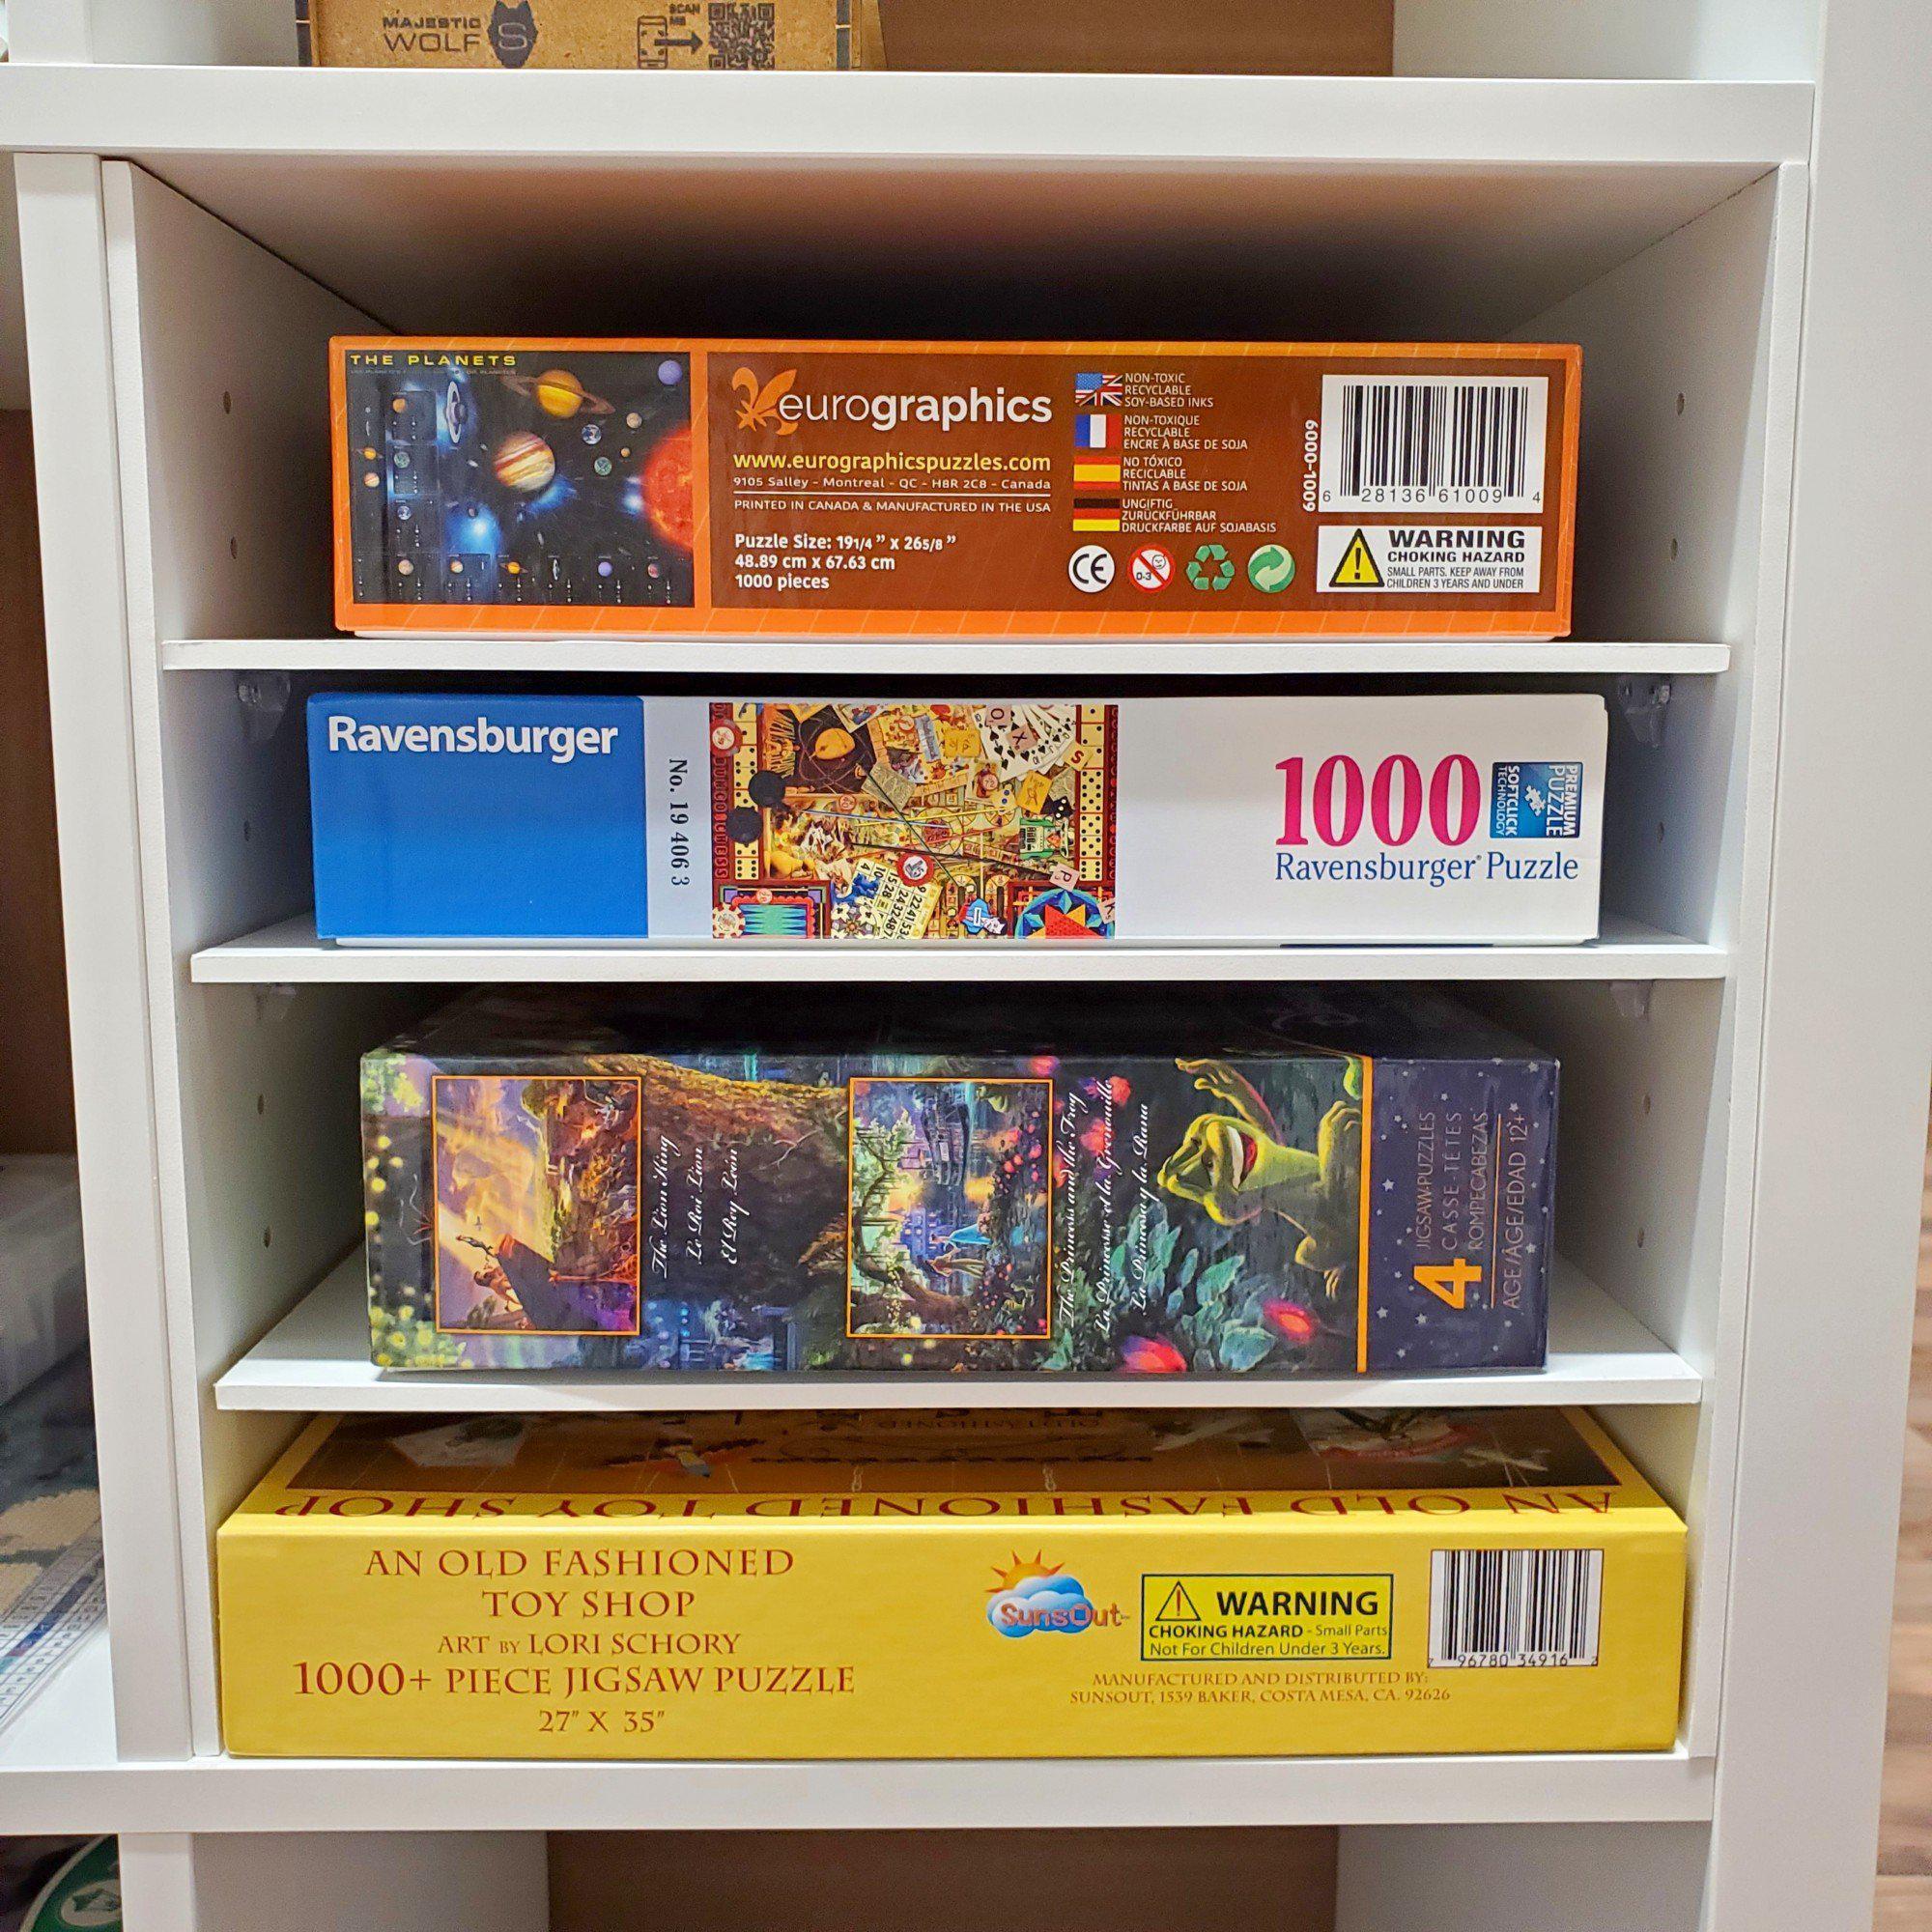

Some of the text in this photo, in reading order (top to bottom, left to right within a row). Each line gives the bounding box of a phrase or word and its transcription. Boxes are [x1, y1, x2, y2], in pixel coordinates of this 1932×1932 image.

[383, 16, 481, 29] MAJESTIC
[384, 33, 481, 52] WOLF
[350, 355, 517, 367] THE PLANETS
[1124, 373, 1186, 384] NON-TOXIC
[1124, 385, 1192, 396] RECYCLABLE
[779, 386, 1053, 432] eurographics
[1124, 397, 1214, 408] SOY-BASED INKS
[1123, 415, 1200, 427] NON-TOXIQUE
[1123, 427, 1190, 438] RECYCLABLE
[1123, 440, 1248, 450] ENCRE BASE DE SOJA
[733, 452, 1051, 473] www.eurographicspuzzles.com
[1122, 455, 1182, 468] NO TÓXICO
[1302, 419, 1319, 513] 6000-1009
[733, 476, 1051, 491] 9105 Salley Montreal QC H8R 2C8 Canada
[1122, 469, 1187, 479] RECICLABLE
[1122, 481, 1248, 491] TINTAS BASE DE SOJA
[1362, 489, 1503, 503] 28136 61009
[734, 499, 1051, 513] PRINTED IN CANADA & MANUFACTURED IN THE USA
[1122, 498, 1173, 509] UNGIFTIG
[1122, 508, 1216, 521] ZURÜCKFÜHRBAR
[1122, 523, 1277, 532] DRUCKFARBE AUF SOJABASIS
[735, 533, 832, 550] Puzzle Size:
[1388, 529, 1525, 549] WARNING
[735, 554, 895, 570] 48.89 cm 67.63 cm
[1387, 551, 1525, 563] CHOKING HAZARD
[1073, 554, 1107, 584] CE
[1387, 566, 1524, 577] SMALL PARTS. KEEP AWAY FROM
[735, 574, 830, 591] 1000 pieces
[1387, 578, 1524, 589] CHILDREN YEARS AND UNDER
[327, 715, 618, 764] Ravensburger
[1275, 753, 1482, 847] 1000
[1495, 766, 1507, 836] TECHNOLOGY
[1505, 765, 1520, 837] SOFTCLICK
[1546, 765, 1565, 837] PUZZLE
[1563, 765, 1578, 837] PREMIUM
[668, 758, 690, 869] No. 19 406
[1486, 851, 1579, 880] Puzzle
[1510, 1115, 1528, 1143] 12+
[1468, 1112, 1489, 1250] ROMPECABEZAS
[1095, 1079, 1123, 1304] Princesse Grenouille
[1132, 1103, 1149, 1283] Princesa Rana
[649, 1134, 682, 1278] The Lion King
[685, 1147, 703, 1265] Le Roi Lion
[1056, 1092, 1089, 1328] The Princess and the Frog
[720, 1237, 738, 1264] El
[1413, 1258, 1483, 1310] 4
[274, 1492, 1614, 1520] AN OLD FASHIONED TOY SHOP
[364, 1548, 794, 1579] AN OLD FASHIONED
[481, 1589, 696, 1619] TOY SHOP
[1216, 1591, 1378, 1616] WARNING
[1000, 1602, 1122, 1627] SunsOut
[1149, 1624, 1387, 1638] CHOKING HAZARD Small Parts
[437, 1633, 741, 1656] ART BY LORI SCHORY
[1150, 1641, 1385, 1656] Not For Children Under Years.
[1458, 1653, 1569, 1667] 96780 34916
[293, 1661, 856, 1699] 1000+ PIECE JIGSAW PUZZLE
[1092, 1671, 1429, 1686] MANUFACTURED AND DISTRIBUTED BY:
[1260, 1690, 1316, 1702] COSTA
[1373, 1689, 1401, 1701] CA.
[1405, 1688, 1450, 1701] 92626
[587, 1710, 609, 1732] X
